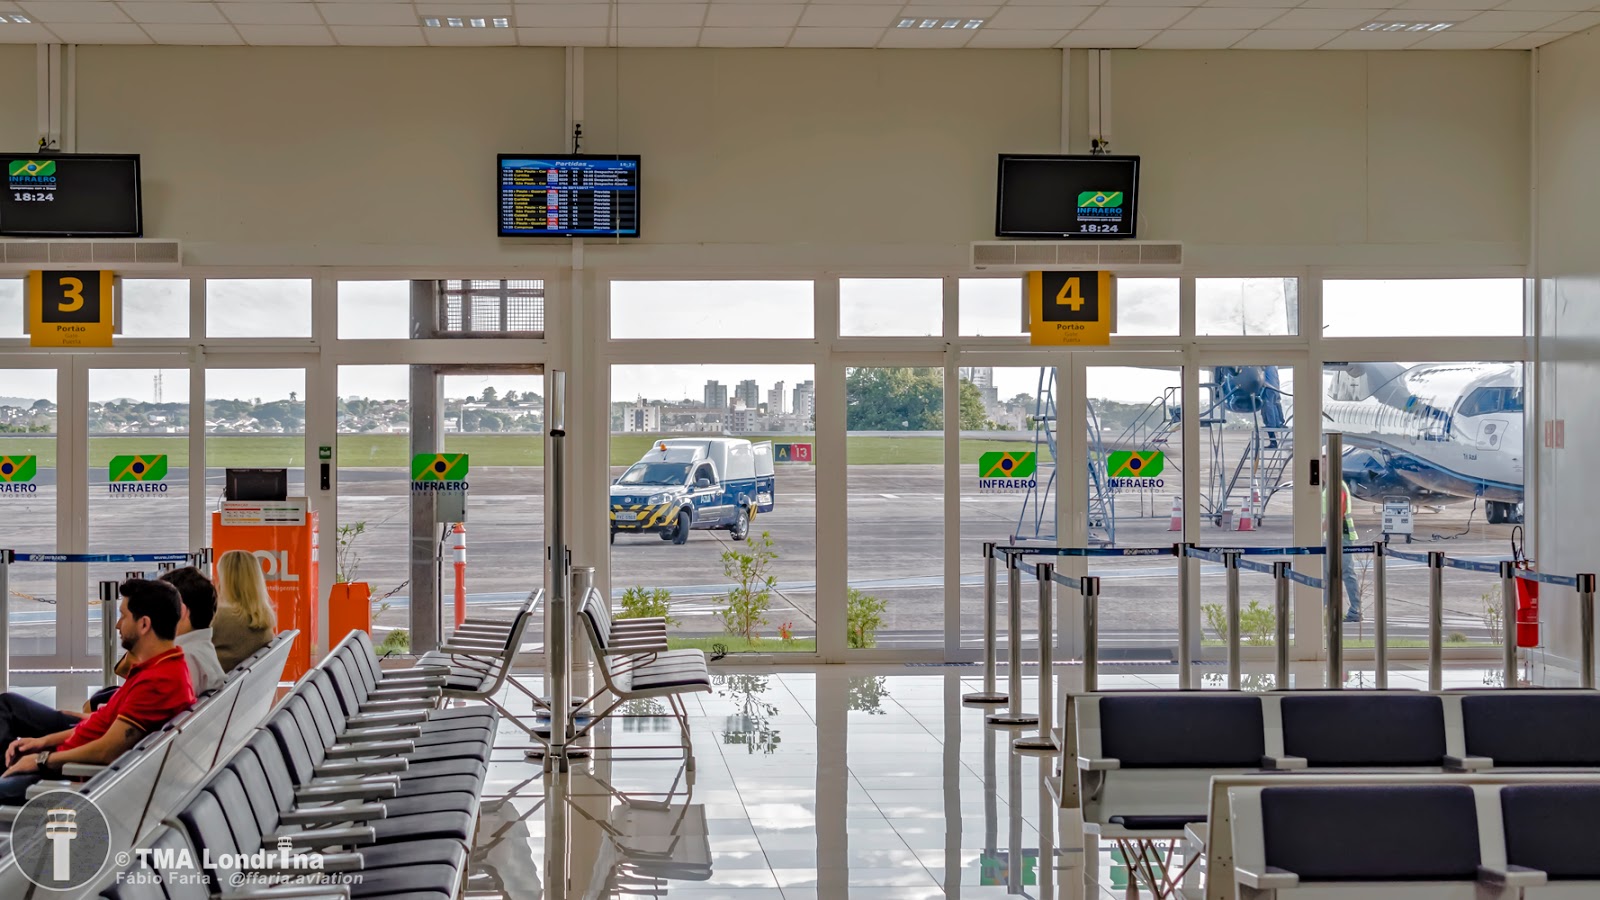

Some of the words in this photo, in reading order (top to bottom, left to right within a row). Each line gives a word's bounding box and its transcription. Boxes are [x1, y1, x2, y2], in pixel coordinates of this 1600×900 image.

[14, 193, 54, 201] 18:24
[1080, 224, 1118, 232] 18:24
[58, 277, 84, 312] 3
[1056, 277, 1085, 311] 4
[779, 448, 787, 458] A
[796, 448, 807, 458] 13
[109, 483, 168, 492] INFRAERO
[412, 482, 469, 491] INFRAERO
[979, 479, 1036, 488] INFRAERO
[1108, 478, 1164, 488] INFRAERO
[252, 550, 299, 582] OL
